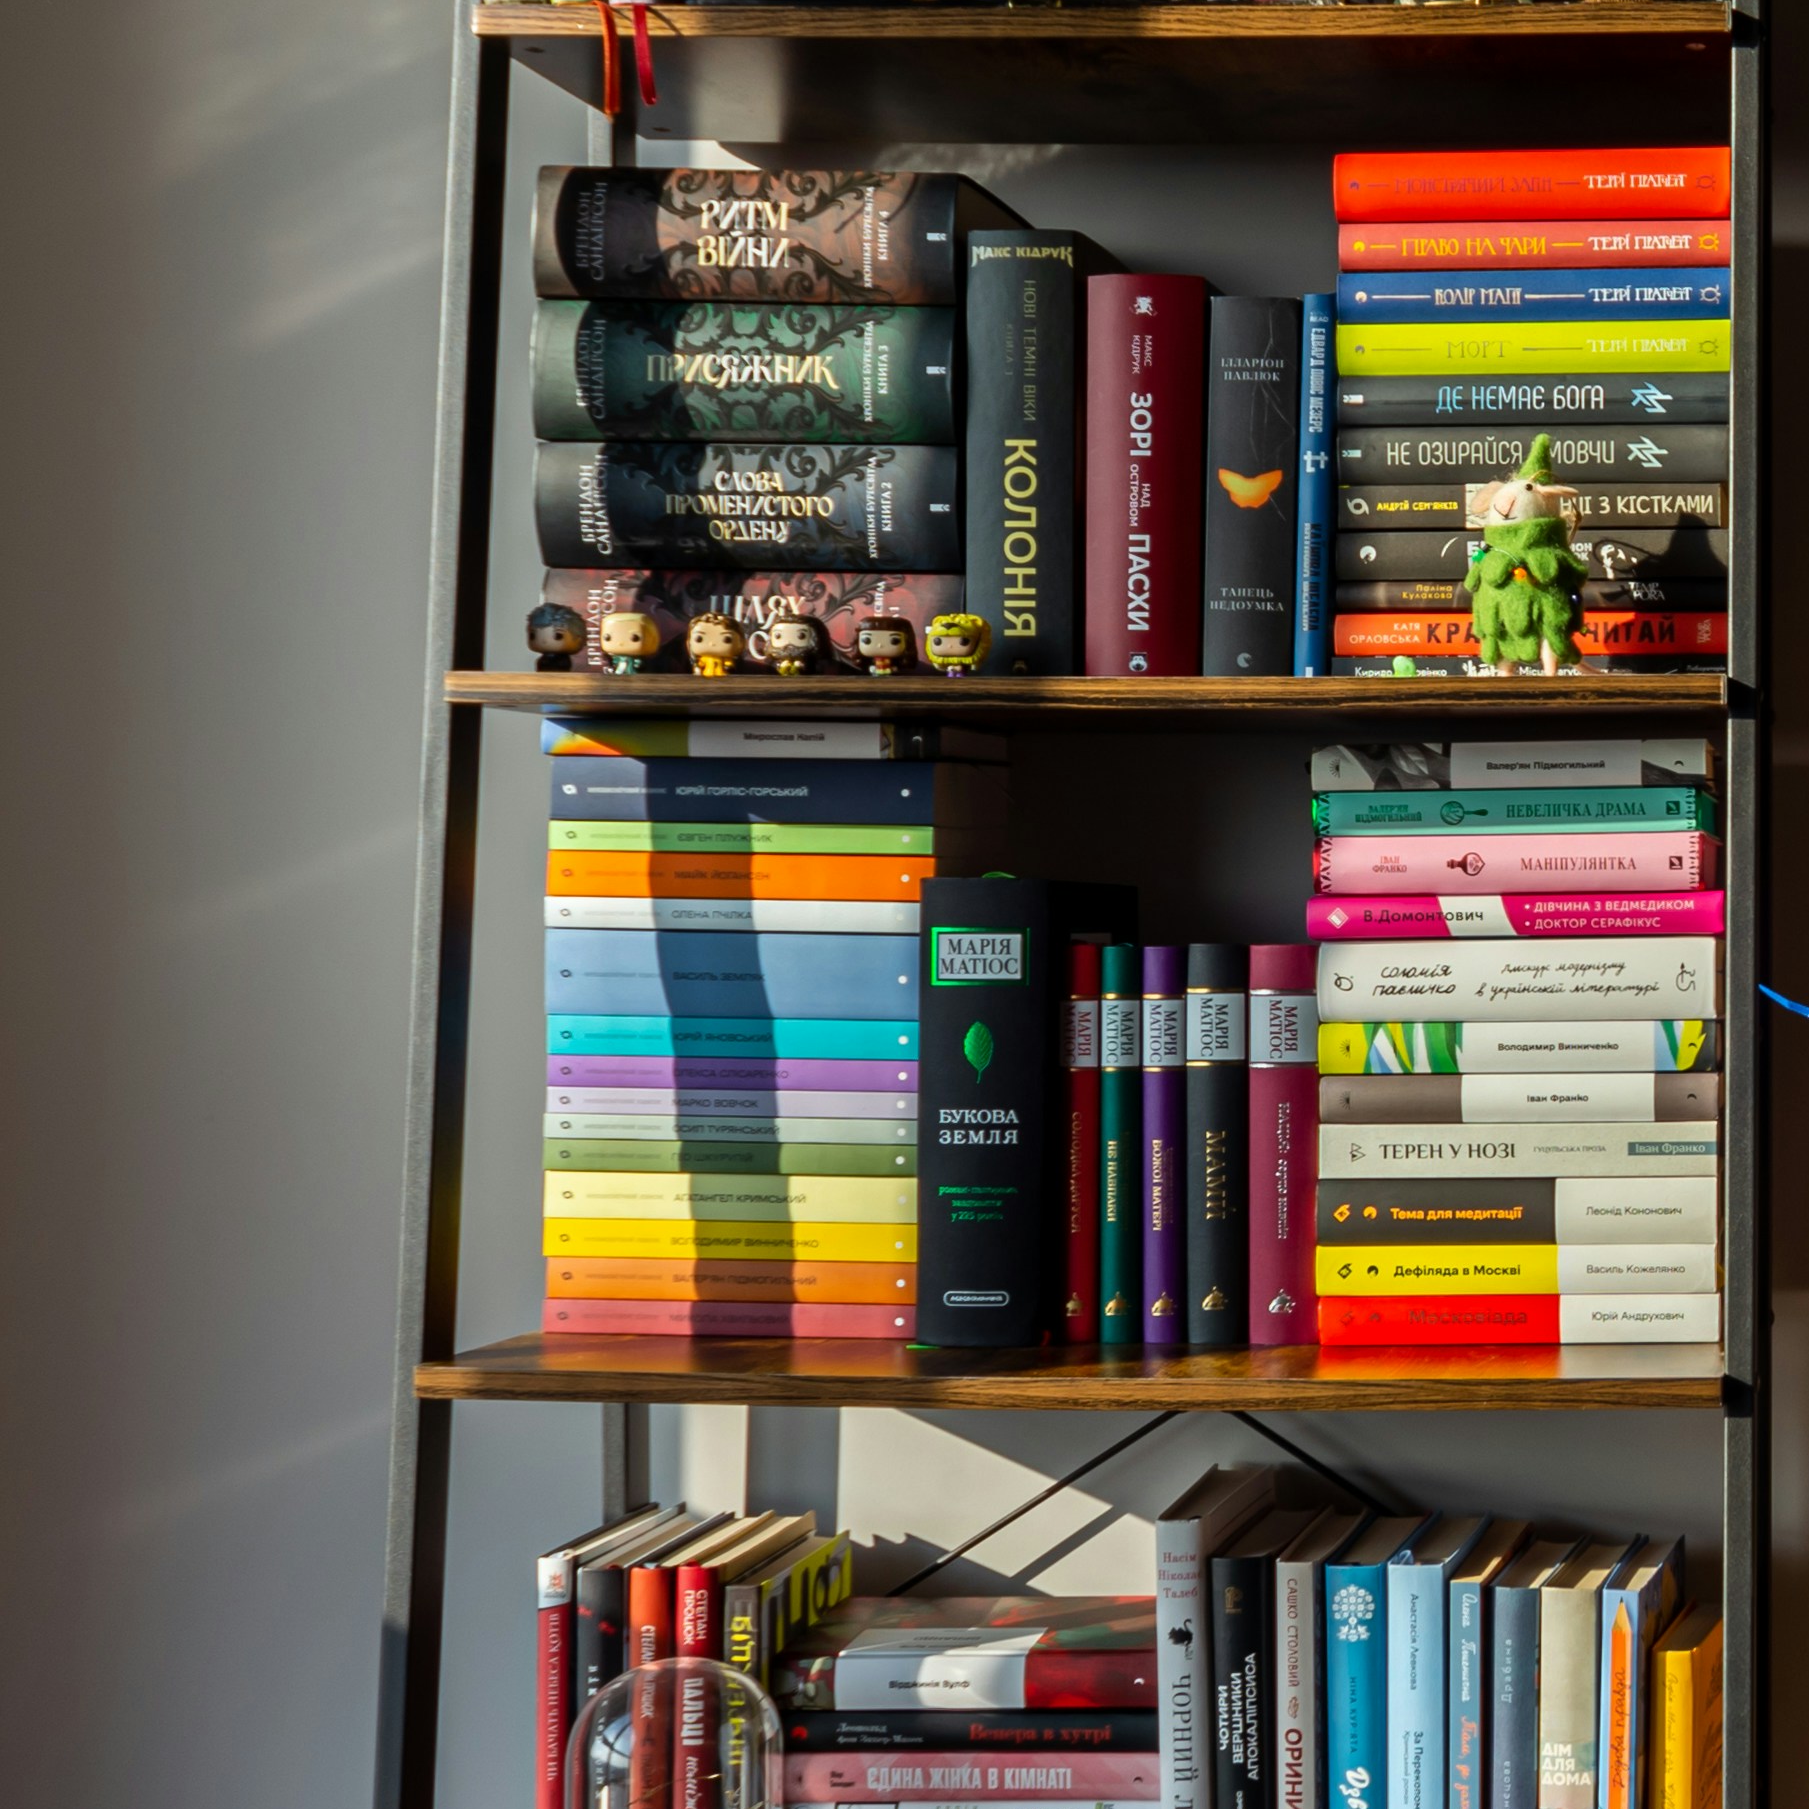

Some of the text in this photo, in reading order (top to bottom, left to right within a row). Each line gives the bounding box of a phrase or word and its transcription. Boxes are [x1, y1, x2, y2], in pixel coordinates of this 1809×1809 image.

[700, 199, 789, 231] РИТМ
[696, 232, 790, 268] ВІЙНИ
[1401, 236, 1547, 257] ПРАВО НА ЧАРИ
[1434, 287, 1523, 306] КОЛІР МАГІЇ
[1023, 279, 1037, 422] НОВІ ТЕМНІ ВІКИ
[1131, 334, 1141, 375] КІДРУК
[1143, 334, 1153, 367] МАКС
[1446, 340, 1513, 359] МОРТ
[646, 353, 839, 391] ПРИСЯЖНИК
[1220, 357, 1285, 369] ІЛЛАРІОН
[1223, 370, 1281, 382] ПАВЛЮК
[1434, 385, 1605, 414] ДЕ НЕМАЄ БОГА
[1129, 391, 1153, 457] ЗОРІ
[1387, 435, 1522, 466] НЕ ОЗИРАЙСЯ
[1549, 440, 1615, 464] МОВЧИ
[715, 471, 784, 492] СЛОВА
[666, 494, 835, 517] ПРОМЕНИСТОГО
[1129, 463, 1140, 527] ОСТРОВОМ
[1140, 483, 1151, 508] НАД
[709, 520, 791, 544] ОРДЕНУ
[1003, 438, 1037, 637] КОЛОНІЯ
[1127, 533, 1151, 631] ПАСХИ
[1219, 587, 1274, 599] ТАНЕЦЬ
[1209, 600, 1285, 612] НЕДОУМКА
[1402, 591, 1453, 601] Кулакова
[586, 589, 602, 666] БРЕНДОН
[1394, 622, 1421, 631] КАТЯ
[1349, 634, 1420, 644] ОРЛОВСЬКА
[1505, 802, 1646, 819] НЕВЕЛИЧКА ДРАМА
[1520, 857, 1637, 872] МАНІПУЛЯНТКА
[1534, 901, 1589, 914] ДІВЧИНА
[1605, 899, 1695, 912] ВЕДМЕДИКОМ
[1534, 916, 1662, 930] ДОКТОР СЕРАФІКУС
[947, 937, 1012, 956] МАРІЯ
[940, 956, 1020, 975] МАТІОС
[1106, 1003, 1119, 1064] МАТІОС
[1121, 1010, 1134, 1056] МАРІЯ
[1149, 1003, 1163, 1063] МАТІОС
[1164, 1010, 1177, 1056] МАРІЯ
[1200, 997, 1213, 1057] МАТІОС
[1214, 1003, 1229, 1050] МАРІЯ
[1268, 999, 1283, 1059] МАТІОС
[1283, 1005, 1298, 1052] МАРІЯ
[1498, 1041, 1620, 1053] Володимир Винниченко
[1526, 1093, 1589, 1104] Іван Франко
[939, 1109, 1019, 1124] БУКОВА
[939, 1129, 1019, 1144] ЗЕМЛЯ
[1378, 1142, 1516, 1160] ТЕРЕН У НОЗІ
[1635, 1142, 1706, 1155] Іван Франко
[1390, 1206, 1524, 1220] Тема для медитації
[1585, 1206, 1683, 1217] Леонід Кононович
[1393, 1264, 1521, 1279] Дефіляда в Москві
[1586, 1264, 1686, 1275] Василь Кожелянко
[1591, 1311, 1685, 1323] Юрій Андрухович
[1163, 1551, 1197, 1563] Насім
[1162, 1586, 1199, 1599] Талеб
[682, 1590, 697, 1646] ПРОЦЮК
[695, 1590, 708, 1640] СТЕПАН
[1286, 1578, 1300, 1687] САШКО СТОЛОВИЙ
[1408, 1593, 1419, 1690] Анастасія Левкова
[1500, 1638, 1513, 1704] Драбина
[1217, 1685, 1230, 1751] ЧОТИРИ
[1231, 1672, 1244, 1764] ВЕРШНИКИ
[1245, 1652, 1260, 1781] АПОКАЛІПСИСА
[1172, 1673, 1198, 1784] ЧОРНИЙ
[1541, 1743, 1572, 1757] ДІМ
[1541, 1757, 1576, 1771] ДЛЯ
[867, 1767, 923, 1791] ЄДИНА
[929, 1767, 982, 1790] ЖІНКА
[988, 1767, 999, 1789] В
[1004, 1766, 1073, 1789] КІМНАТІ
[1541, 1772, 1591, 1786] ДОМА
